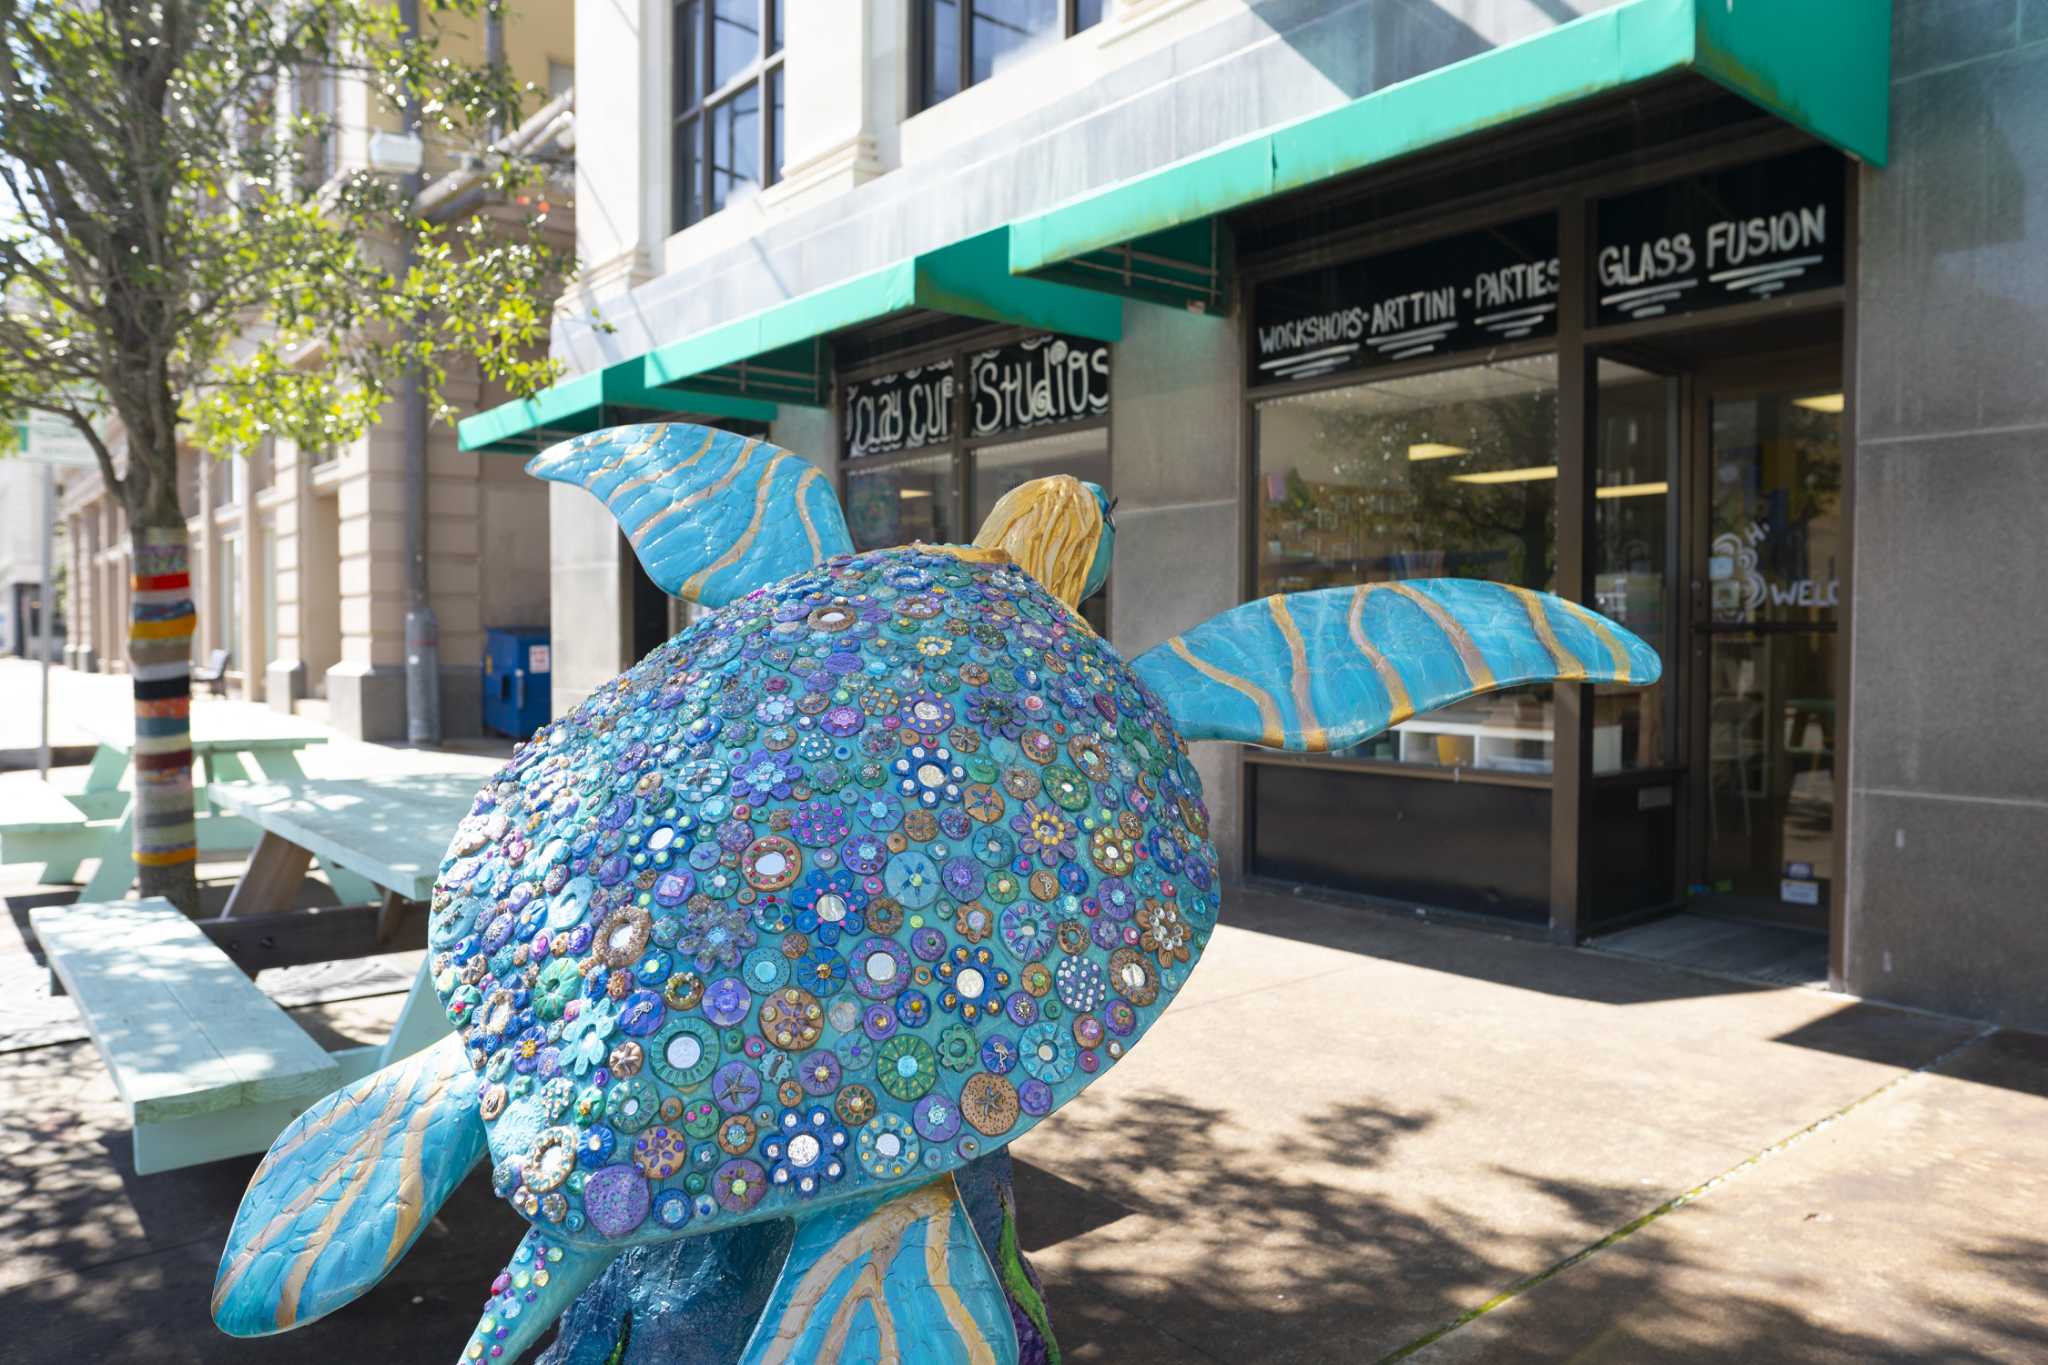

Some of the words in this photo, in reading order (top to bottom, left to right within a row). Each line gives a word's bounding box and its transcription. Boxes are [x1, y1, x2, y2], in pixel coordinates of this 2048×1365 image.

[1599, 233, 1696, 286] GLASS
[1706, 204, 1826, 269] FUSION
[1259, 307, 1363, 353] WORKSHOPS
[1475, 258, 1560, 308] PARTIES
